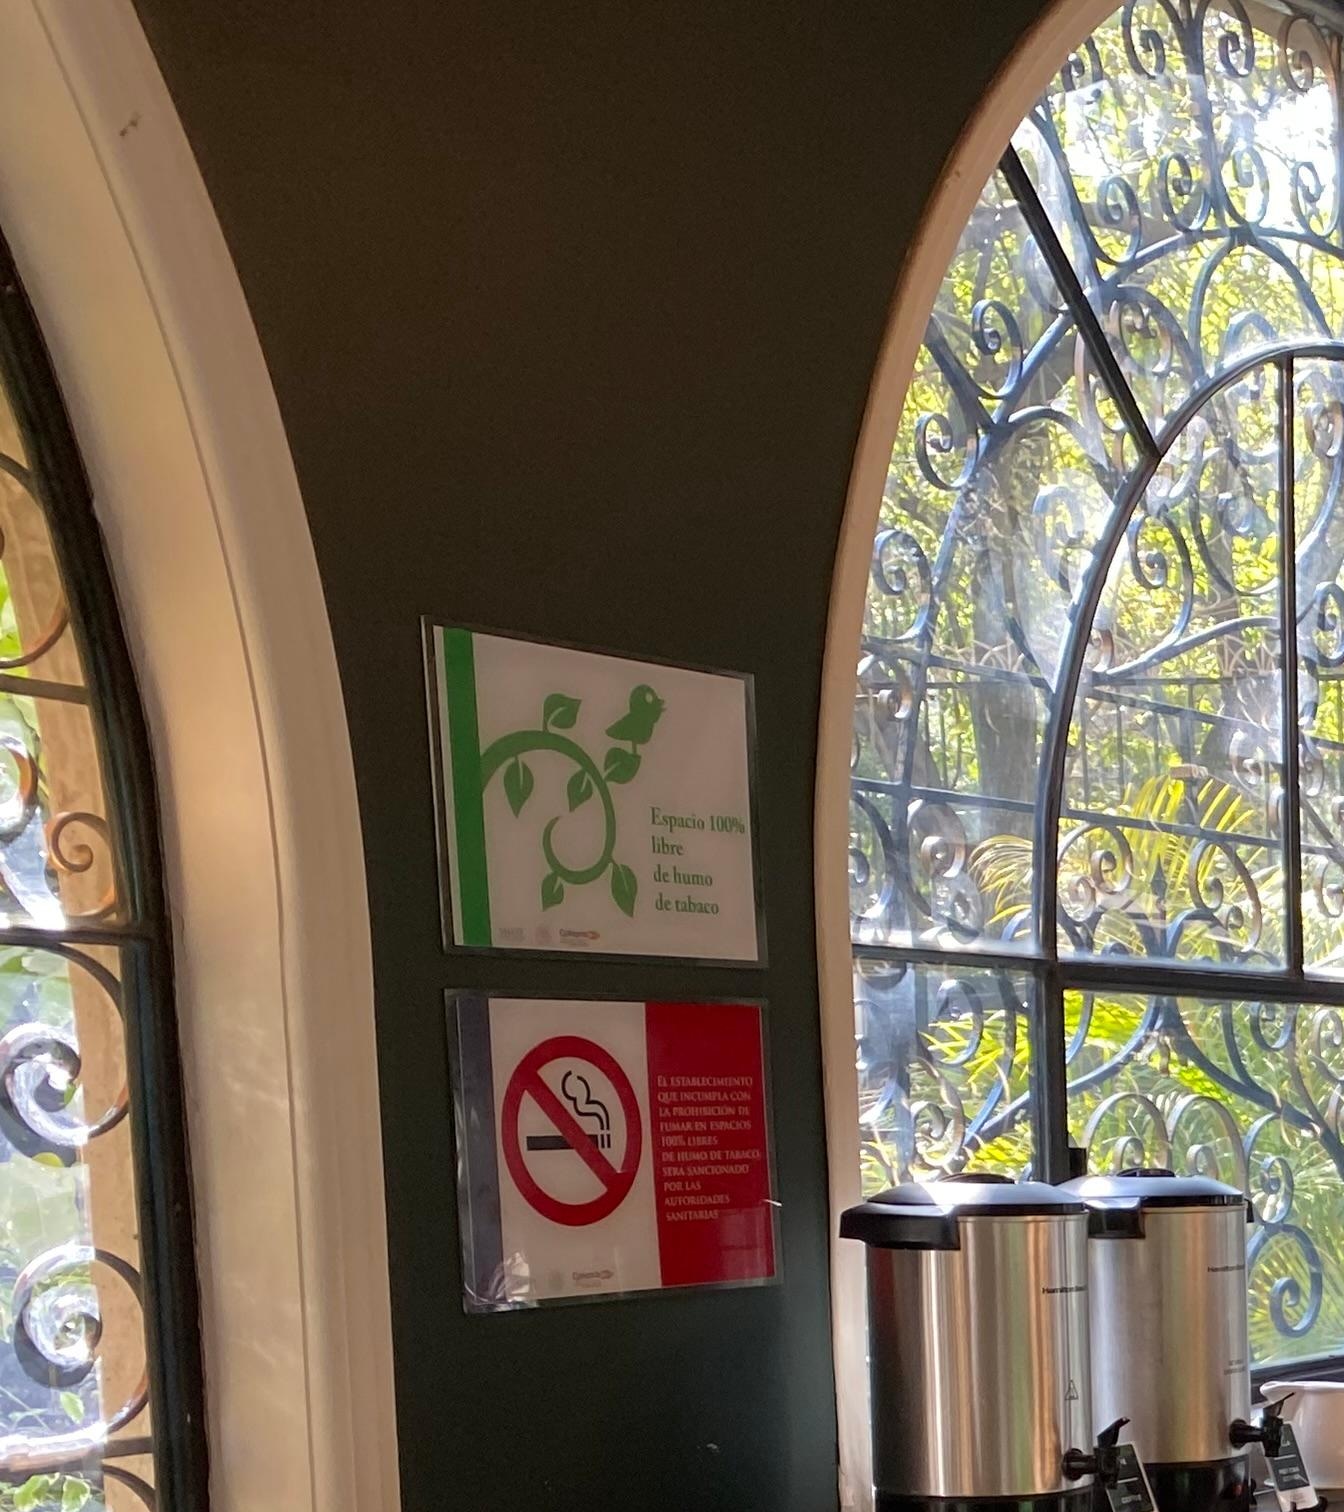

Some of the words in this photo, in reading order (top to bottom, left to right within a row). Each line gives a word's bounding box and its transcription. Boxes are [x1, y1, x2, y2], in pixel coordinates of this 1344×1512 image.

[650, 806, 705, 832] Espacio
[710, 815, 745, 833] 100%
[651, 835, 684, 856] libre
[653, 864, 669, 883] de
[673, 866, 713, 887] humo
[655, 892, 672, 911] de
[675, 895, 719, 915] tabaco
